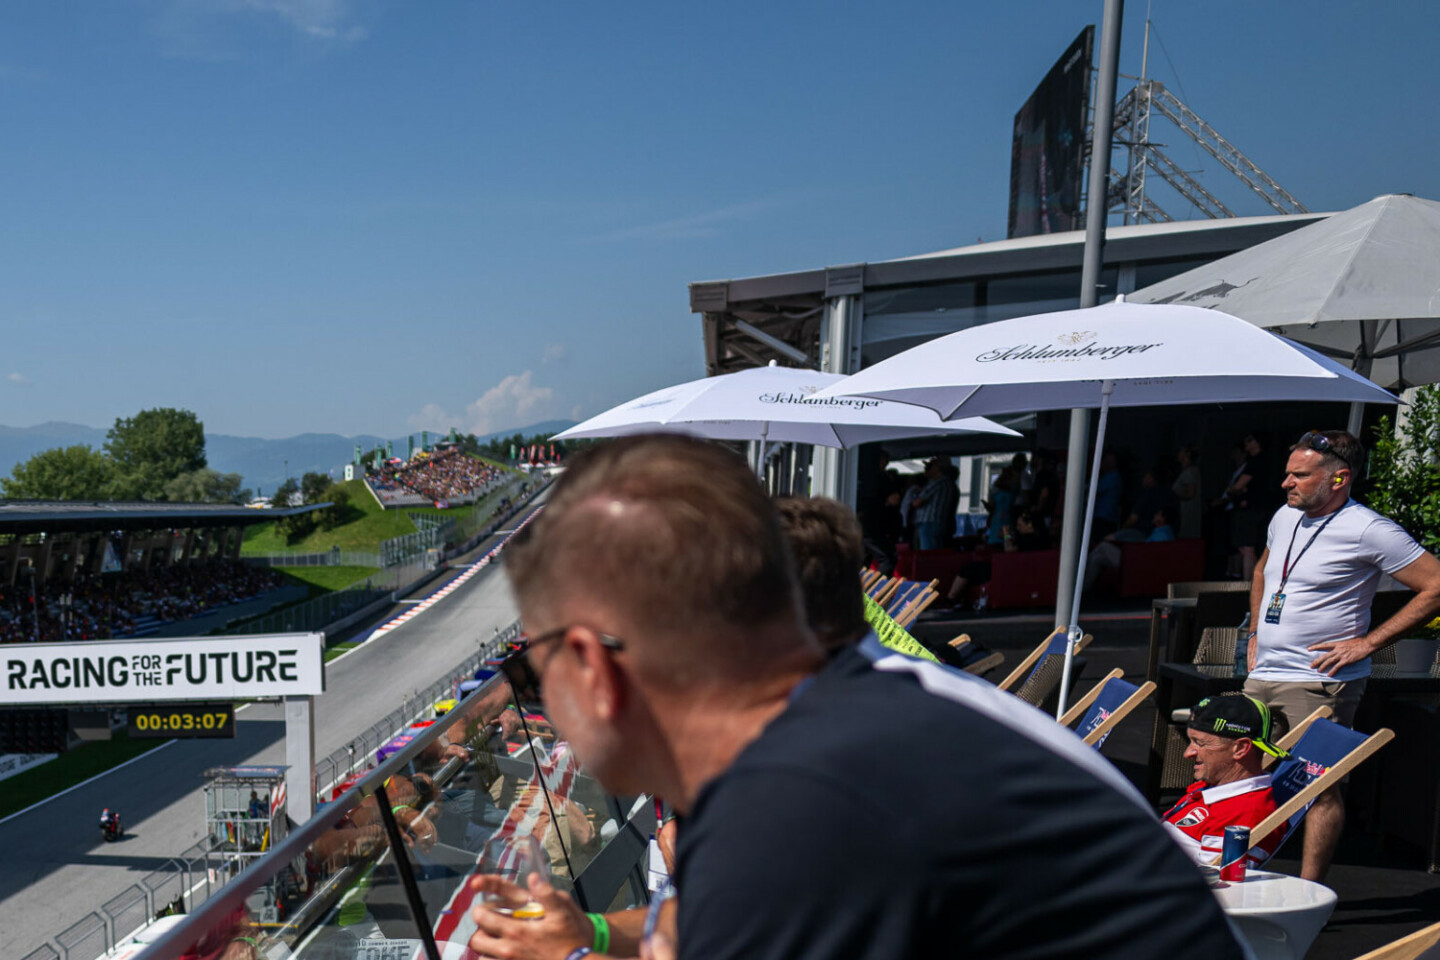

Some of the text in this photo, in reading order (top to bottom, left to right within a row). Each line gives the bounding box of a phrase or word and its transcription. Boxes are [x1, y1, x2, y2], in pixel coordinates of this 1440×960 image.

[976, 341, 1163, 363] Schlumberger
[7, 650, 298, 690] RACING FOR THE FUTURE
[136, 713, 227, 730] 00:03:07
